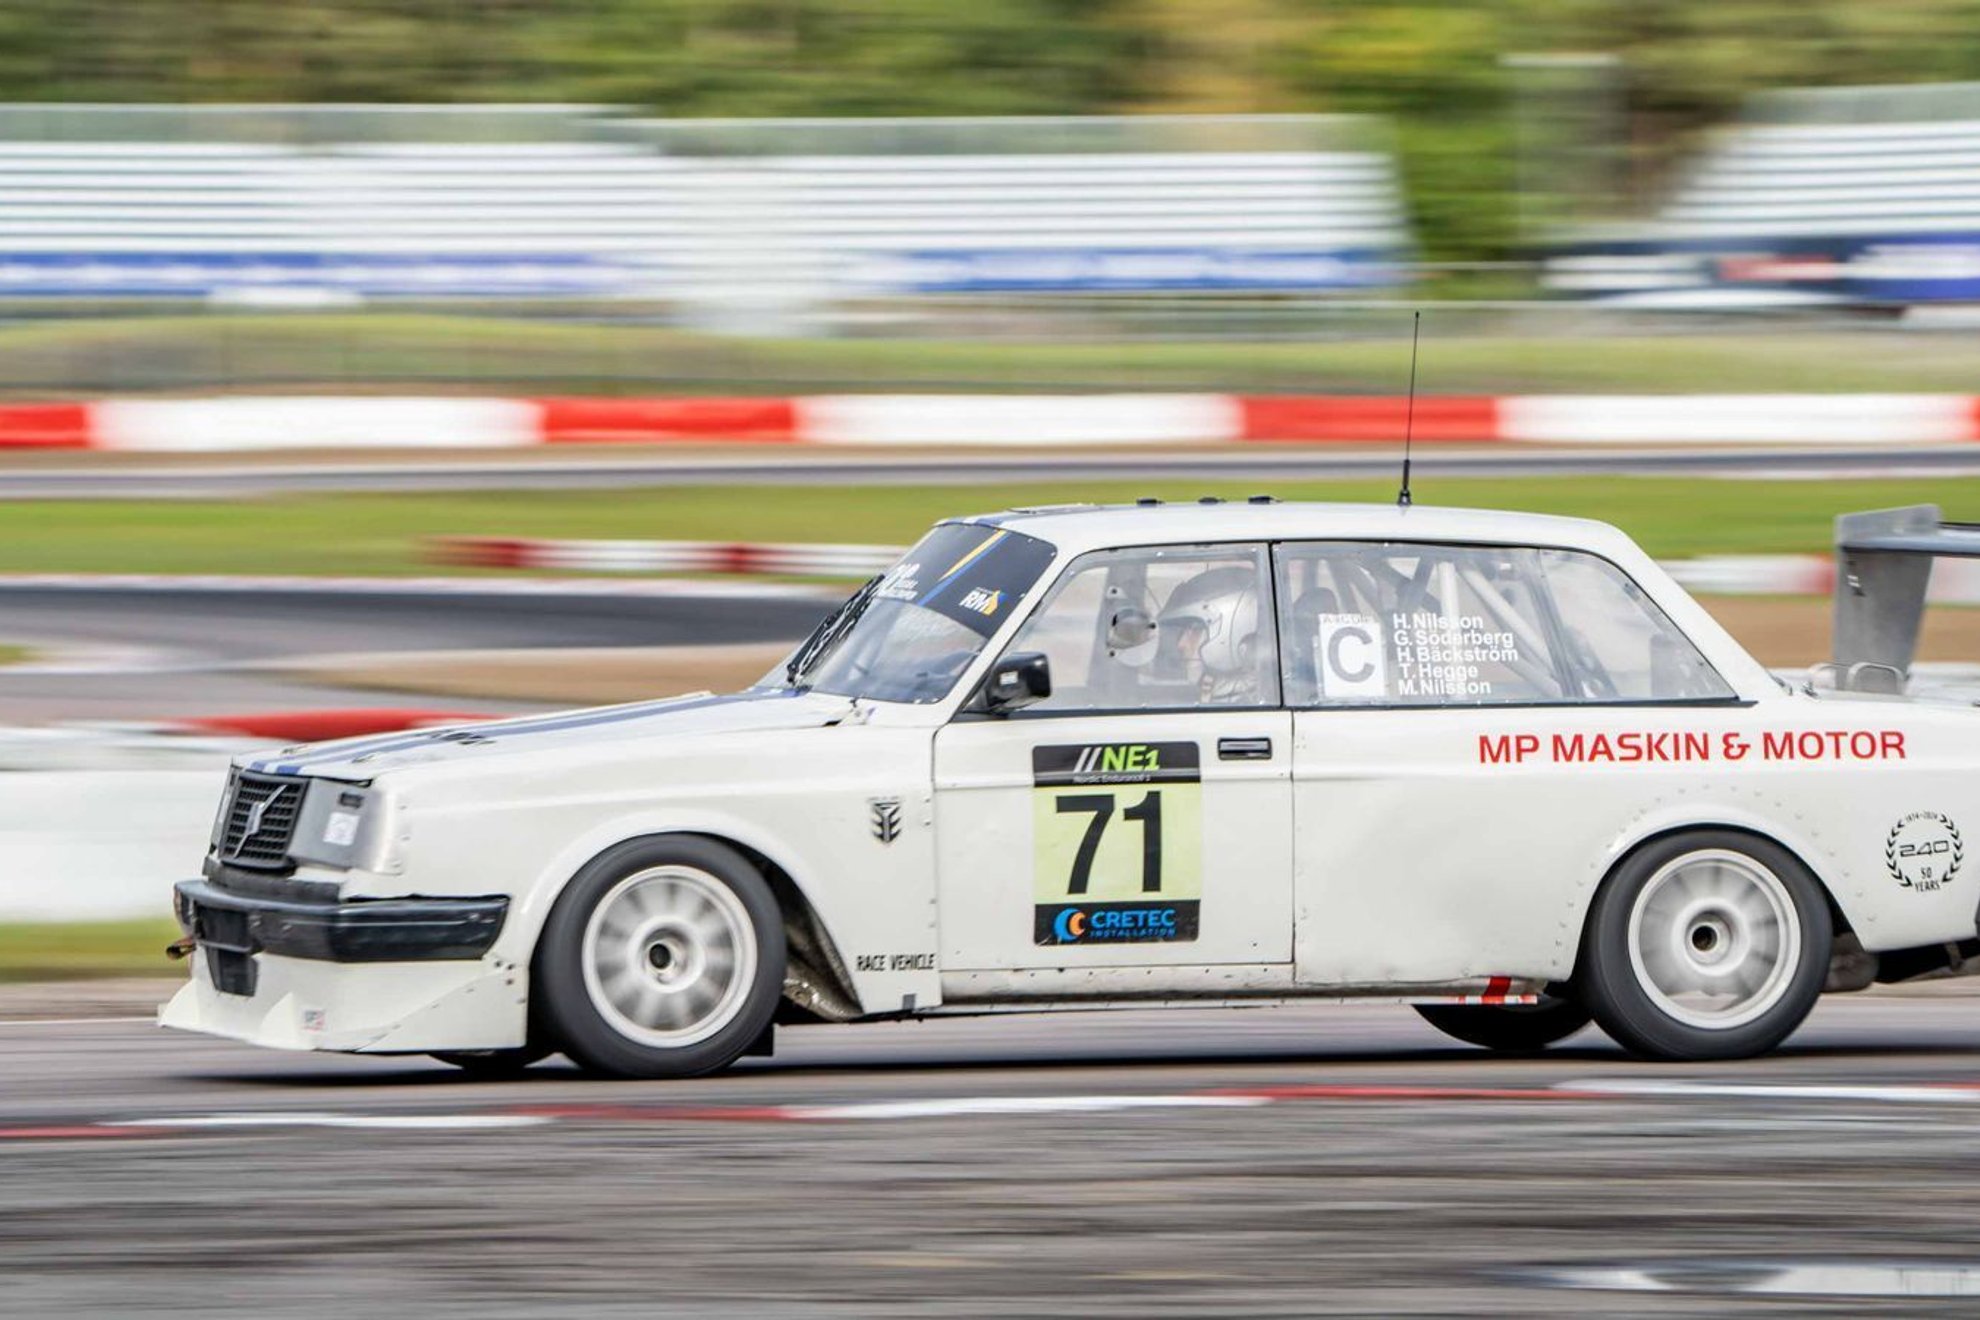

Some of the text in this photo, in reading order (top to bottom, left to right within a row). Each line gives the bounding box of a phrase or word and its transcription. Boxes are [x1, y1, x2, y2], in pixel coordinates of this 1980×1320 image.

[1393, 614, 1483, 629] H. Nilsson
[1394, 629, 1514, 648] G. Söderberg
[1328, 626, 1376, 683] C
[1397, 646, 1518, 662] H. Bäckström
[1400, 664, 1478, 681] T. Hegge
[1399, 680, 1491, 695] M. Nilsson
[1479, 731, 1906, 763] MP MASKIN & MOTOR
[1056, 790, 1161, 894] 71
[1899, 840, 1949, 857] 240
[1914, 880, 1941, 893] YEARS
[1091, 908, 1176, 928] CRETEC
[1090, 927, 1176, 938] INSTALLATION
[857, 952, 935, 971] RACE VEHICLE
